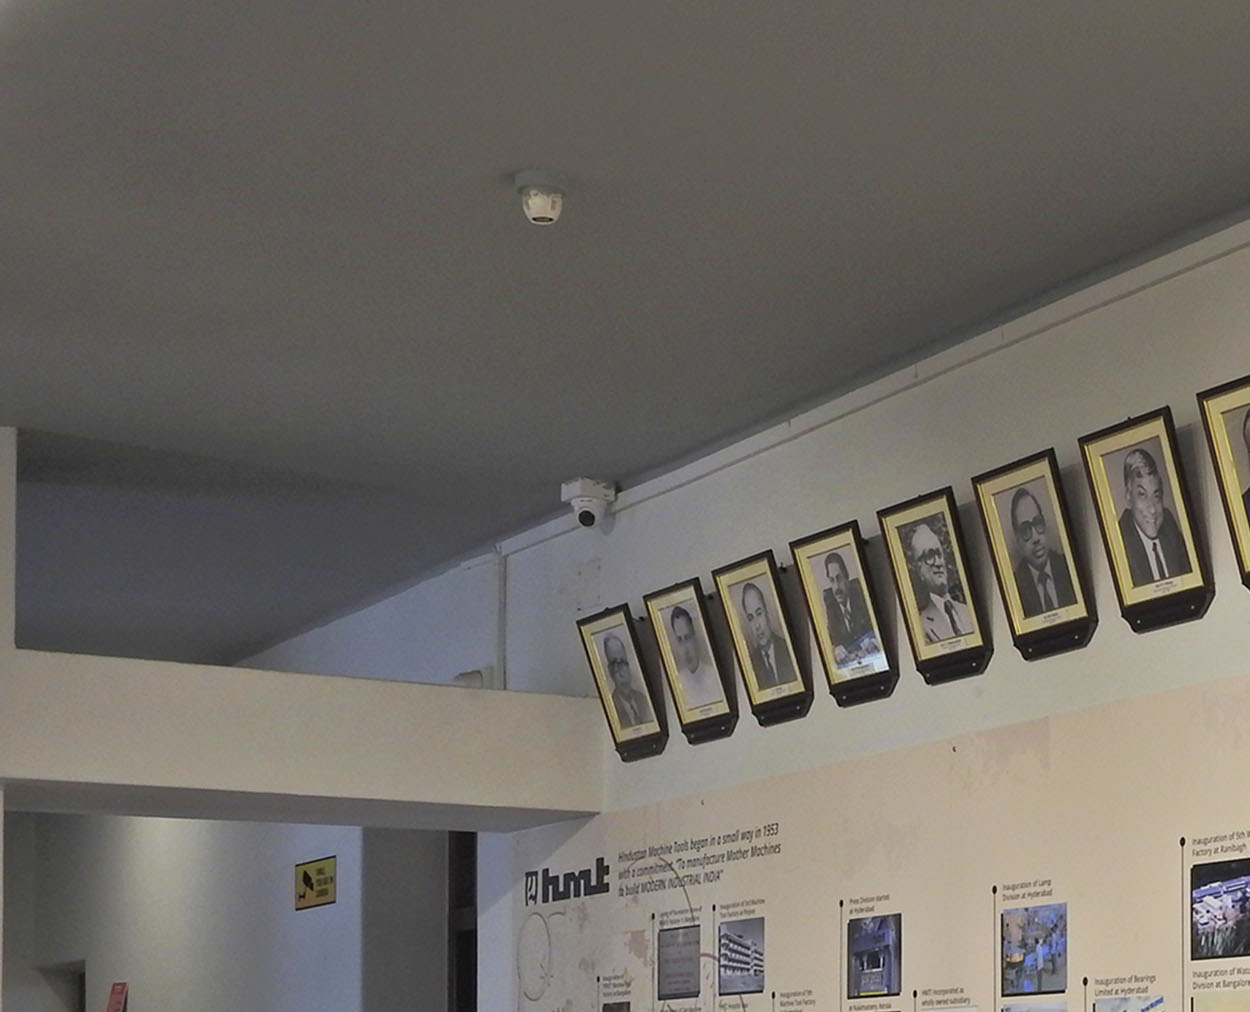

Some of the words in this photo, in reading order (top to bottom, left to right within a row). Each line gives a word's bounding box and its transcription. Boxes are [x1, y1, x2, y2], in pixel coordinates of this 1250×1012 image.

[648, 845, 672, 857] Machine
[674, 840, 688, 853] Tools
[690, 838, 708, 852] began
[723, 829, 739, 844] small
[763, 822, 779, 836] 1953
[727, 848, 749, 861] Mother
[750, 843, 781, 857] Machines
[541, 857, 610, 904] hmt
[1192, 969, 1228, 979] Inauguration
[1192, 981, 1214, 990] Division
